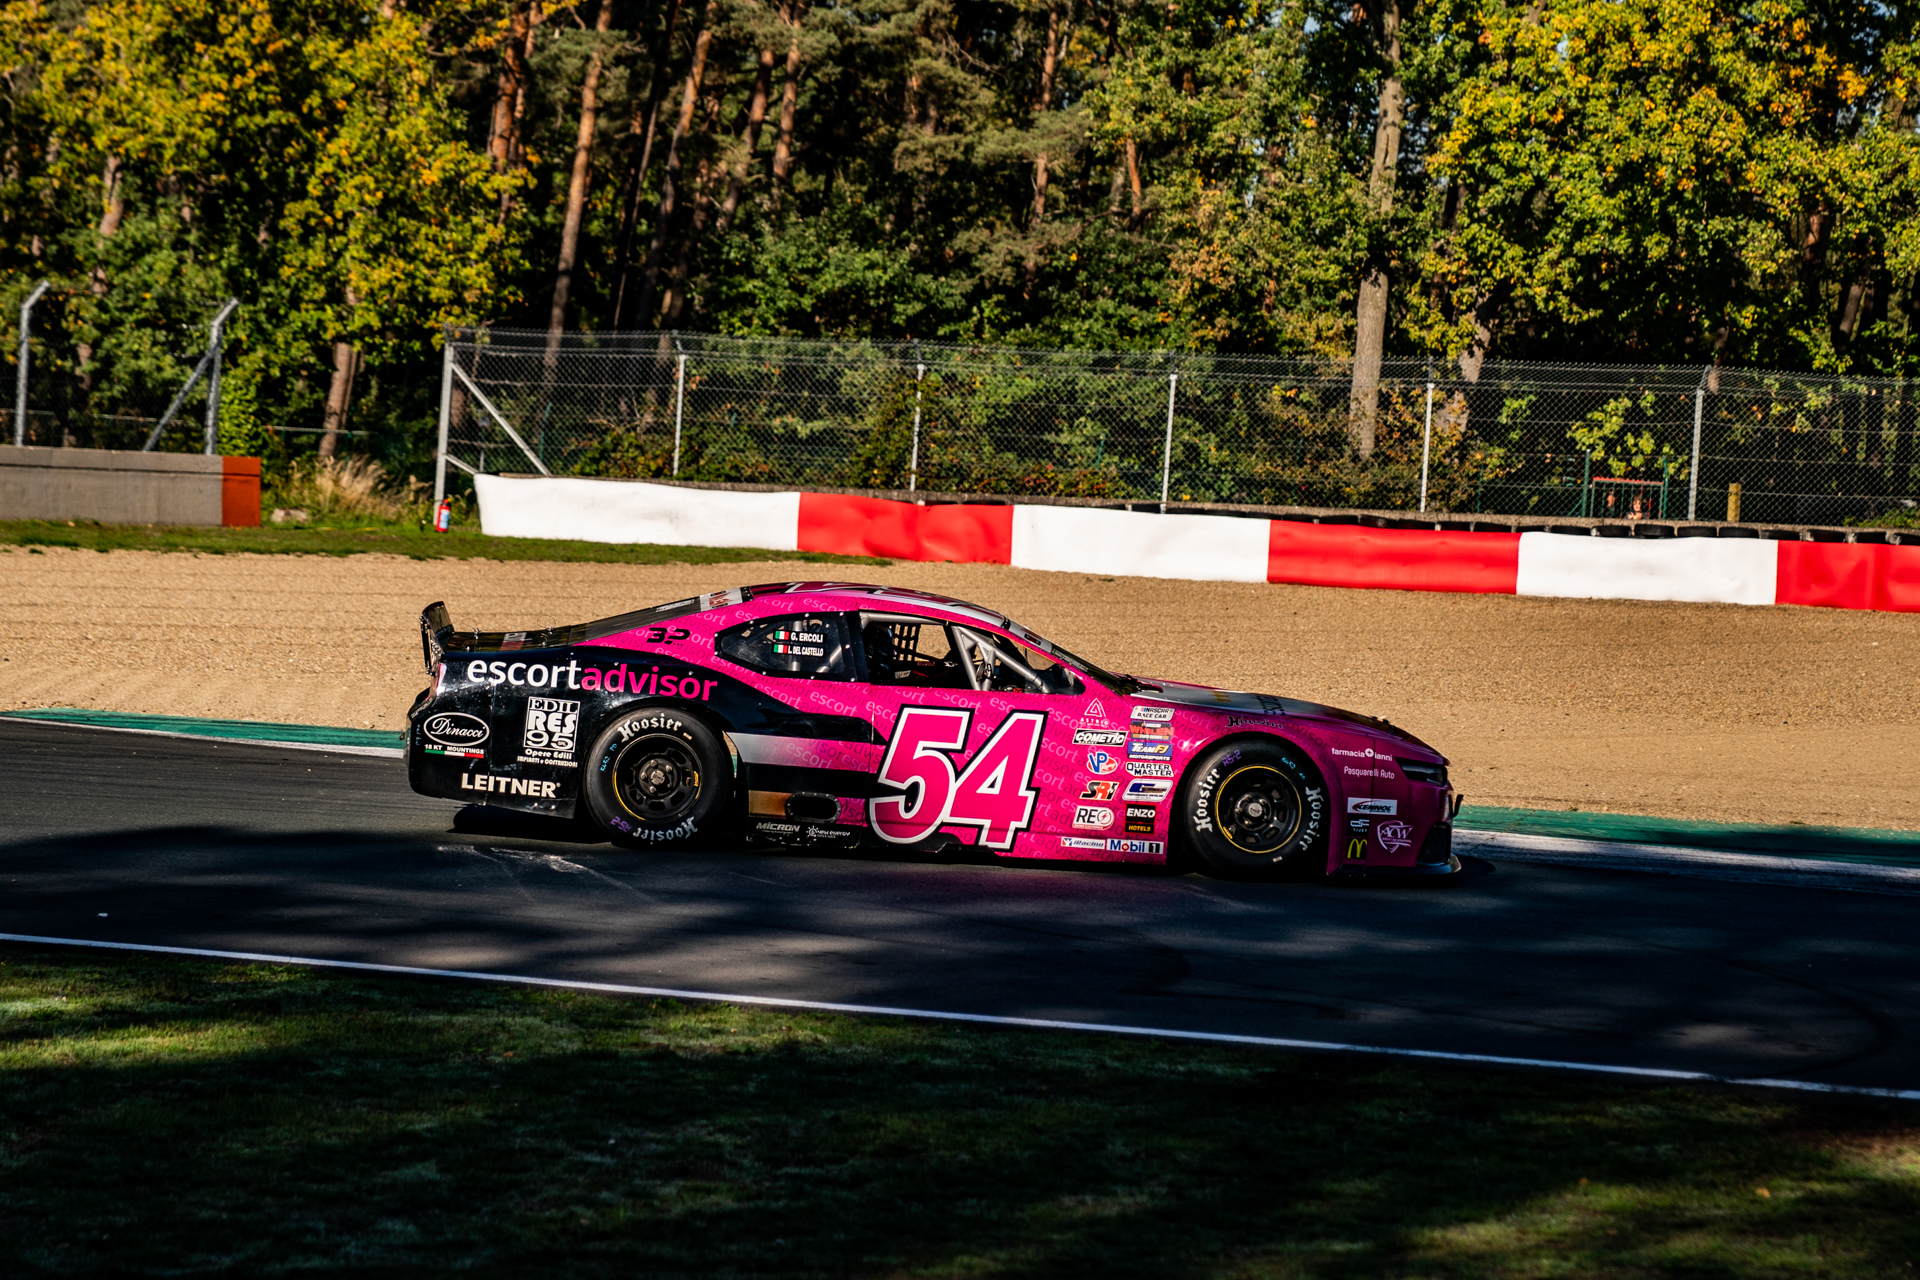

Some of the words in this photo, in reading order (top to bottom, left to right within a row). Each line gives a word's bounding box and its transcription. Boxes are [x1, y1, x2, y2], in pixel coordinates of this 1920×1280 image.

[790, 631, 798, 641] G.
[799, 632, 823, 643] ERCOLI
[792, 646, 801, 655] DEL
[801, 647, 824, 657] CASTELLO
[530, 698, 578, 714] EDIL
[430, 717, 484, 738] Dinacci
[528, 710, 577, 734] RES
[617, 712, 683, 743] Hoosier
[1129, 724, 1175, 736] WHELEN
[526, 730, 574, 750] 95
[1075, 732, 1125, 744] COMETIC
[446, 746, 485, 755] MOUNTINGS
[525, 748, 552, 757] Opere
[553, 751, 573, 760] Edili
[1331, 747, 1365, 758] farmacia
[1126, 762, 1170, 771] QUARTER
[1343, 766, 1379, 778] Pasquarelli
[1380, 769, 1395, 779] Auto
[868, 704, 1049, 852] 54
[1134, 769, 1172, 777] MASTER
[1193, 768, 1221, 833] Hoosier
[1126, 807, 1156, 818] ENZO
[1110, 839, 1146, 853] Mobil
